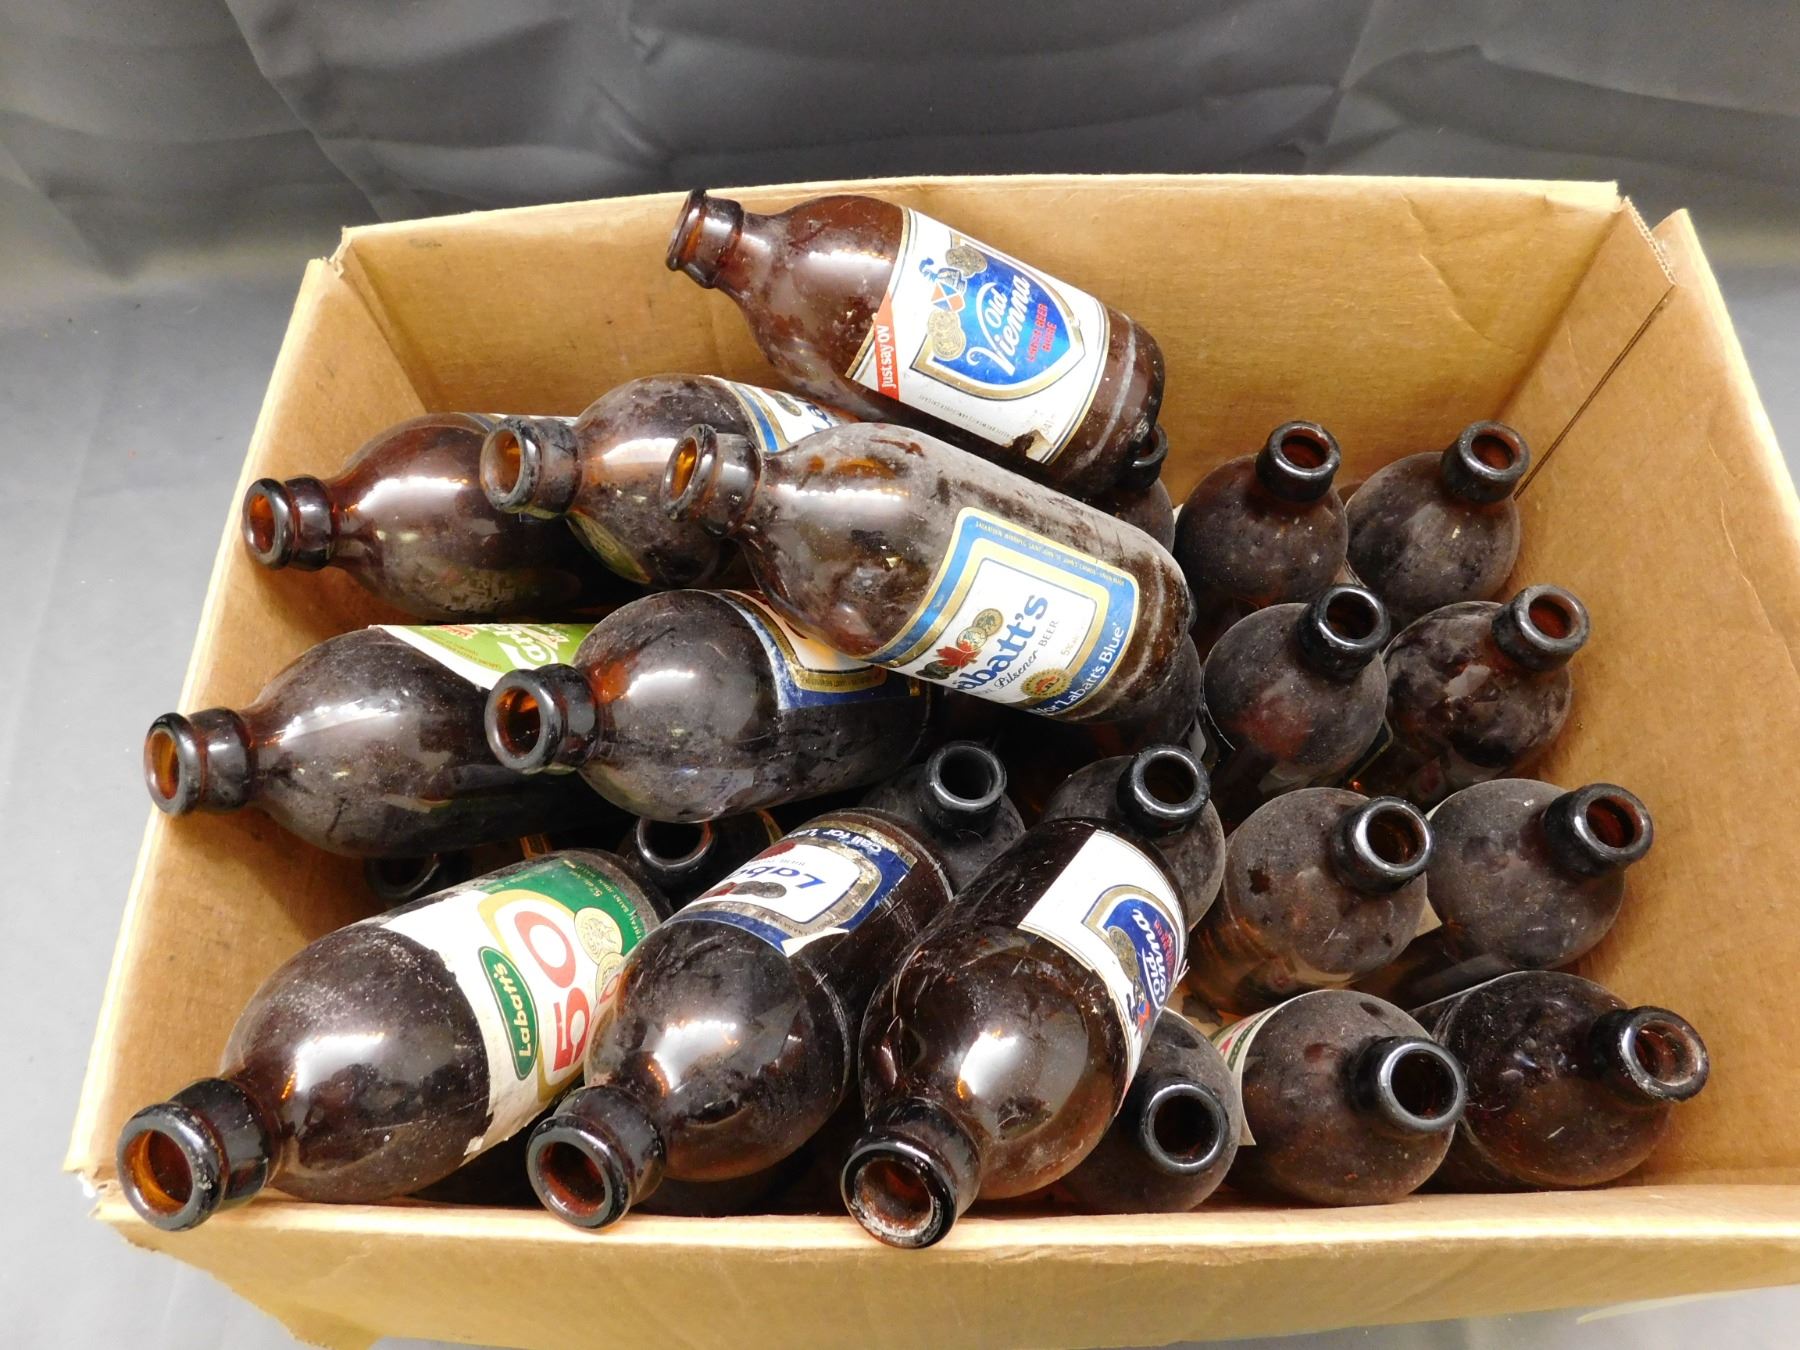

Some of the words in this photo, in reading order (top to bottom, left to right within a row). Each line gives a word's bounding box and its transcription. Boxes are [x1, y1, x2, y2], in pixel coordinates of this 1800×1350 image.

[966, 274, 1032, 376] Vienna
[984, 287, 1008, 328] Old
[1035, 303, 1049, 330] BEER
[876, 325, 891, 343] OV
[881, 341, 895, 363] say
[994, 650, 1038, 690] Pilsener
[1038, 620, 1060, 648] BEER
[822, 828, 850, 841] for
[848, 832, 884, 855] Call
[514, 910, 590, 1072] 50
[1145, 952, 1162, 995] Old
[493, 961, 532, 1057] Labatt's
